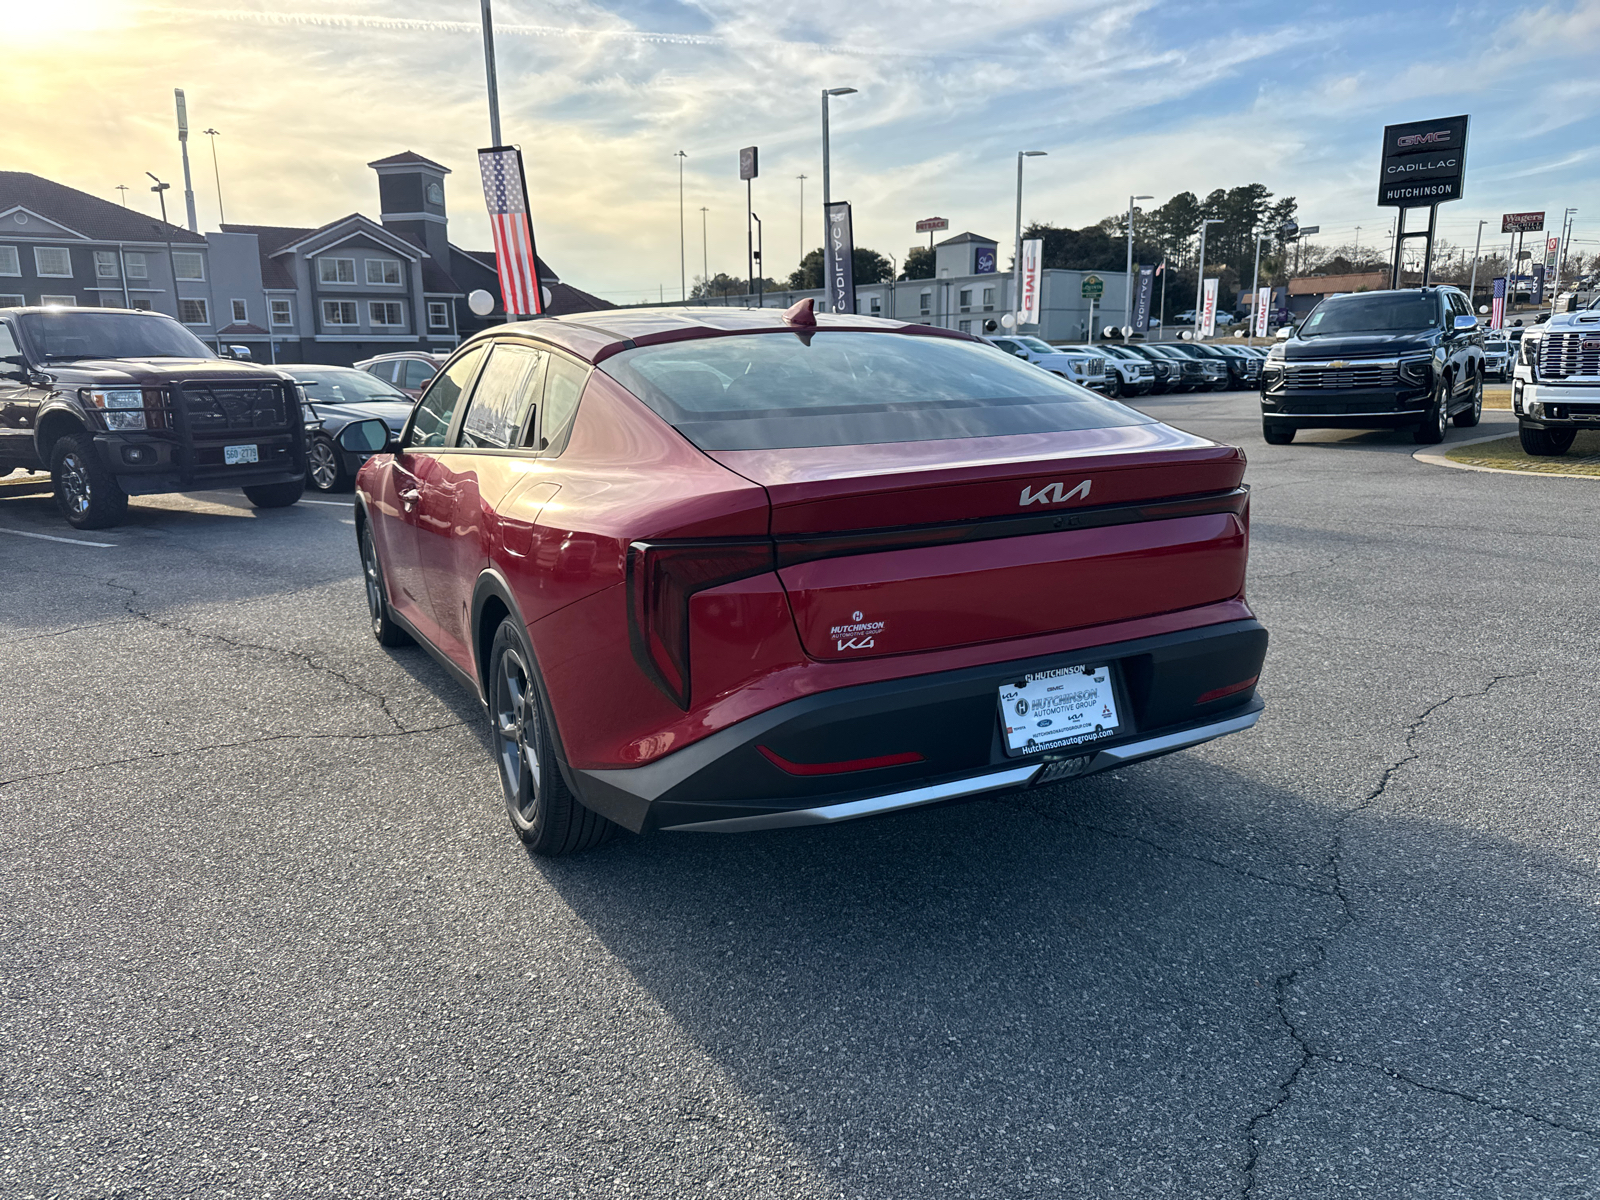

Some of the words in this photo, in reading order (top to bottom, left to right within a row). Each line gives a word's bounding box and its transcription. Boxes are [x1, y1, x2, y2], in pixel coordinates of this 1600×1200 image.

[1397, 130, 1451, 147] GMC
[1387, 159, 1456, 173] CADILLAC
[1387, 184, 1452, 199] HUTCHINSON
[1506, 214, 1543, 223] Wagers
[1019, 480, 1092, 506] KIA
[830, 621, 885, 634] HUTCHINSON
[831, 631, 865, 639] AUTOMOTIVE
[837, 636, 875, 651] K4
[1034, 665, 1086, 680] HUTCHINSON
[1031, 688, 1098, 711] HUTCHINSON
[1033, 704, 1074, 717] AUTOMOTIVE
[1075, 699, 1097, 709] GROUP
[1032, 722, 1092, 738] HUTCHINSONAUTOGROUP.COM
[1022, 730, 1114, 754] Hutchinsonautogroup.com
